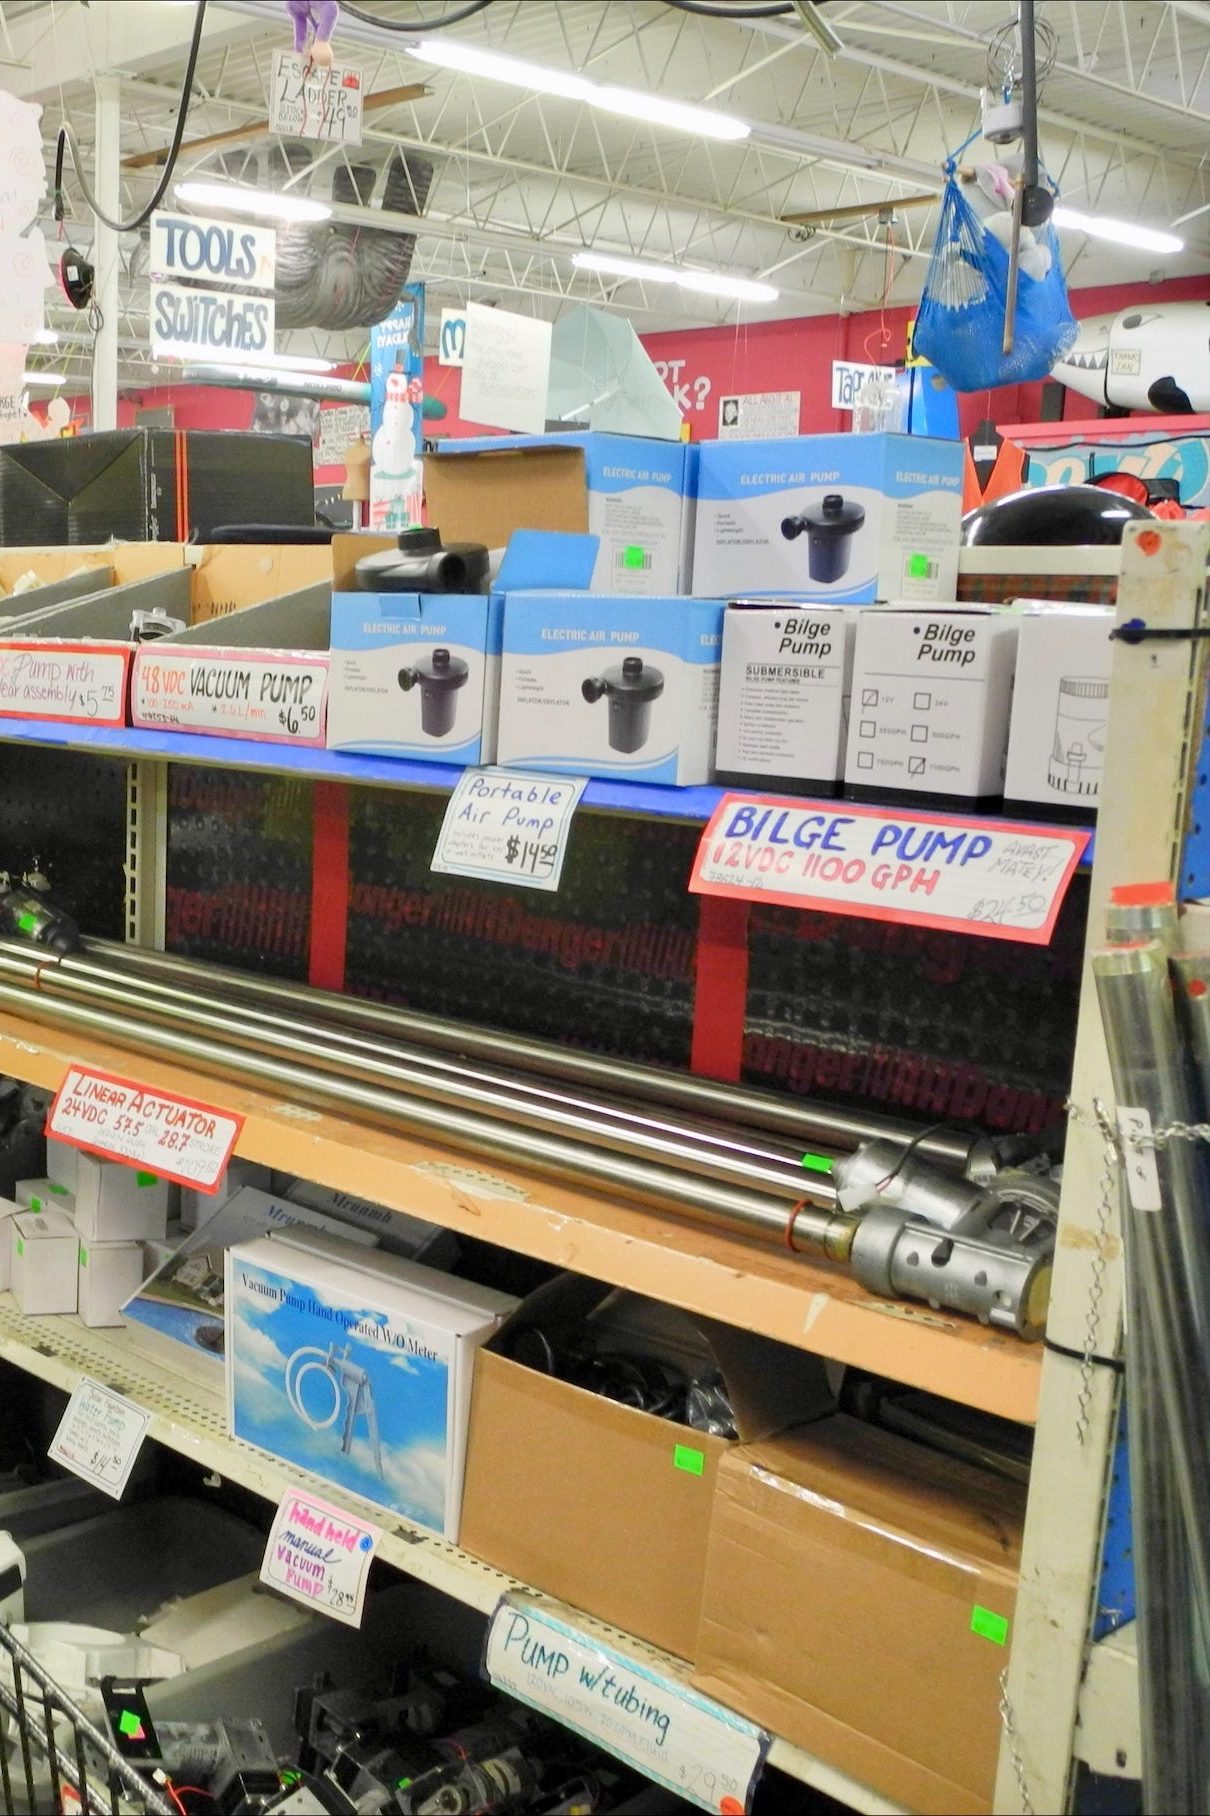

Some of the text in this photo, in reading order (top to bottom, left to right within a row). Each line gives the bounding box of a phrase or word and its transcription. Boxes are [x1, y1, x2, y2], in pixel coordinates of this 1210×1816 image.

[156, 218, 256, 279] TOOLS
[603, 467, 672, 483] ELECTRIC AIR PUMP
[740, 471, 840, 486] ELECTRIC AIR PUMP
[896, 471, 960, 487] ELECTRIC AIR PUMP
[363, 623, 446, 636] ELECTRIC AIR PUMP
[542, 628, 639, 643] ELECTRIC AIR PUMP
[784, 618, 831, 638] Bilge
[924, 623, 976, 644] Bilge
[779, 638, 832, 658] Pump
[917, 644, 976, 666] Pump
[10, 653, 62, 685] Pump
[66, 660, 94, 682] with
[746, 665, 825, 680] SUBMERSIBLE
[23, 683, 78, 712] assembly
[142, 665, 313, 706] 48 VDC VACUUM PUMP
[468, 777, 562, 805] Portable
[458, 802, 554, 839] Air Pump
[725, 806, 993, 866] BILGE PUMP
[1003, 839, 1058, 860] AVAST
[712, 841, 941, 896] 12VDC 1100 GPH
[991, 856, 1063, 883] MATEY!
[72, 1074, 216, 1139] LINEAR ACTUATOR
[62, 1098, 107, 1126] 24VDC
[113, 1114, 143, 1137] 57.5
[158, 1130, 190, 1152] 28.7
[242, 1273, 438, 1363] Vacuum Pump Hand Operated W/O Meter
[278, 1530, 342, 1564] manual
